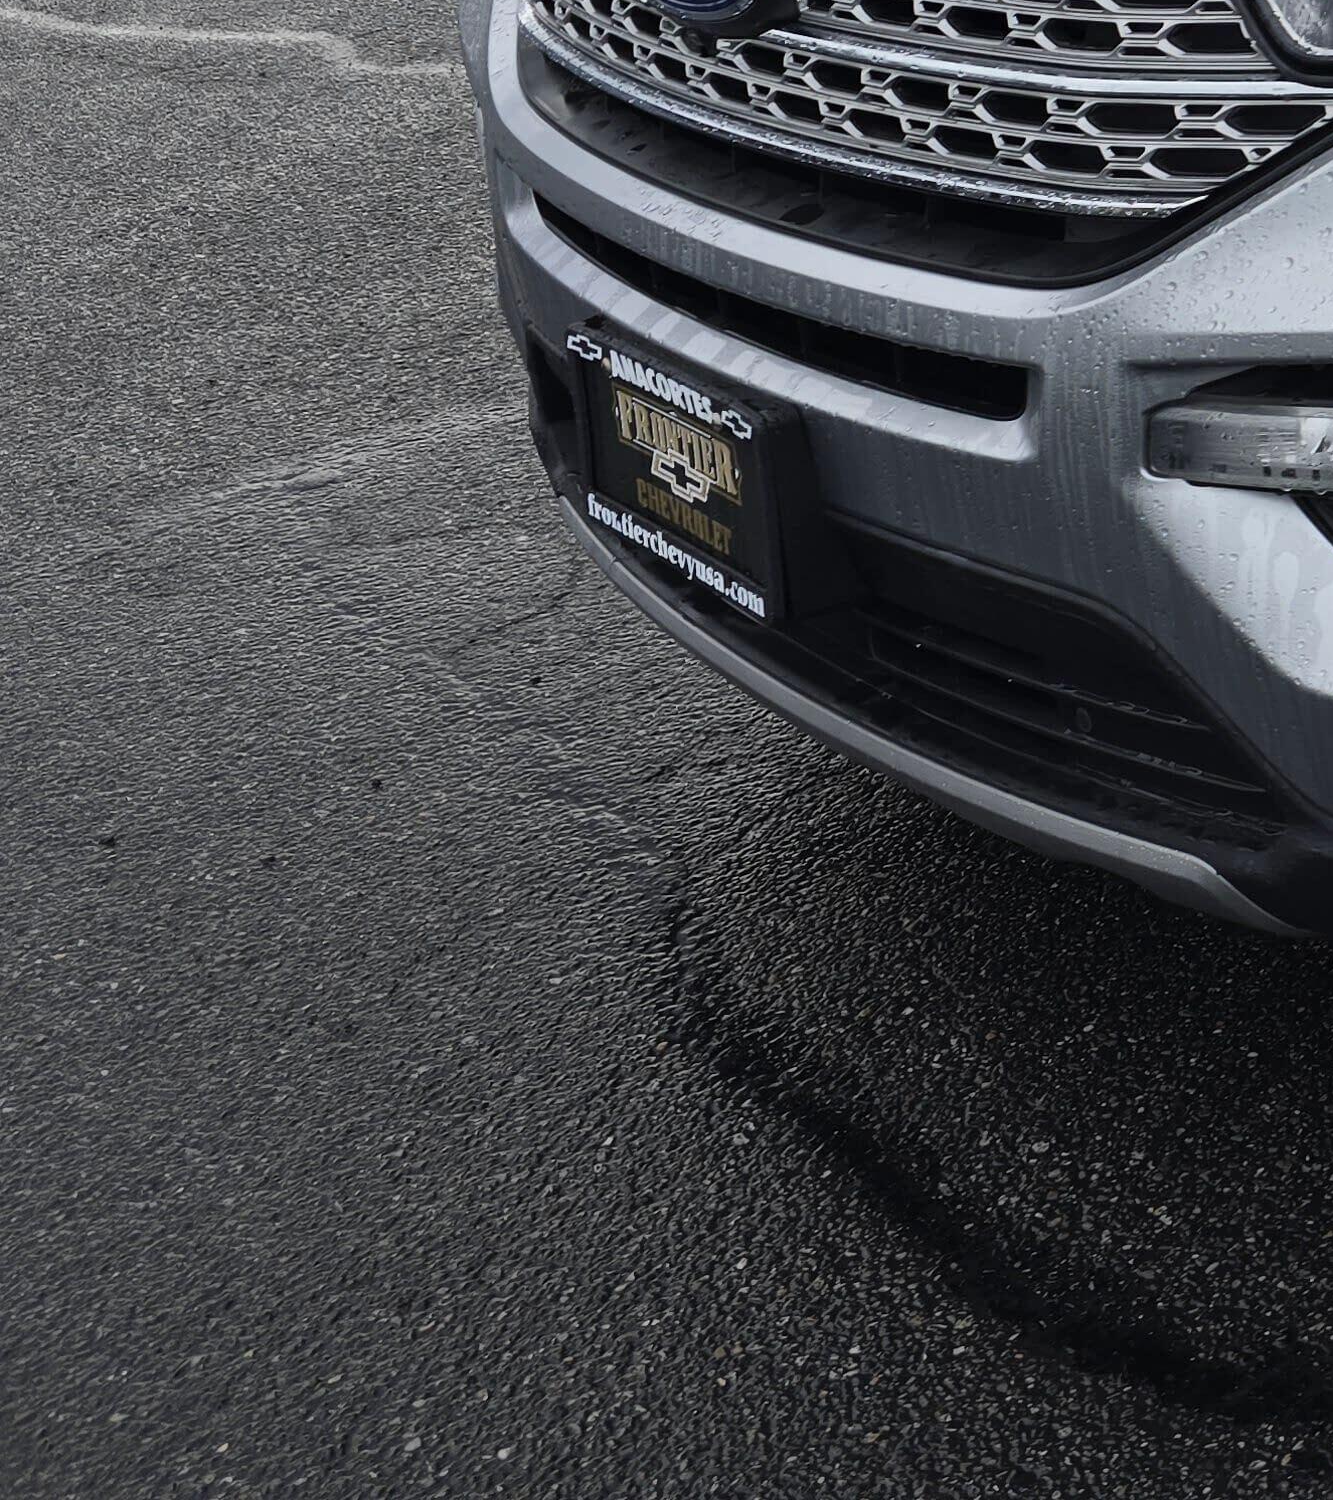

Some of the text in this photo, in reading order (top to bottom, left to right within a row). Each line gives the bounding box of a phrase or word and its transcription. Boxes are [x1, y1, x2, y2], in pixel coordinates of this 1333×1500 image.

[609, 349, 714, 425] ANACORTES
[615, 389, 739, 496] FRONTIER
[587, 492, 767, 619] frontierchevyusa.com
[636, 477, 733, 556] CHEVROLET
